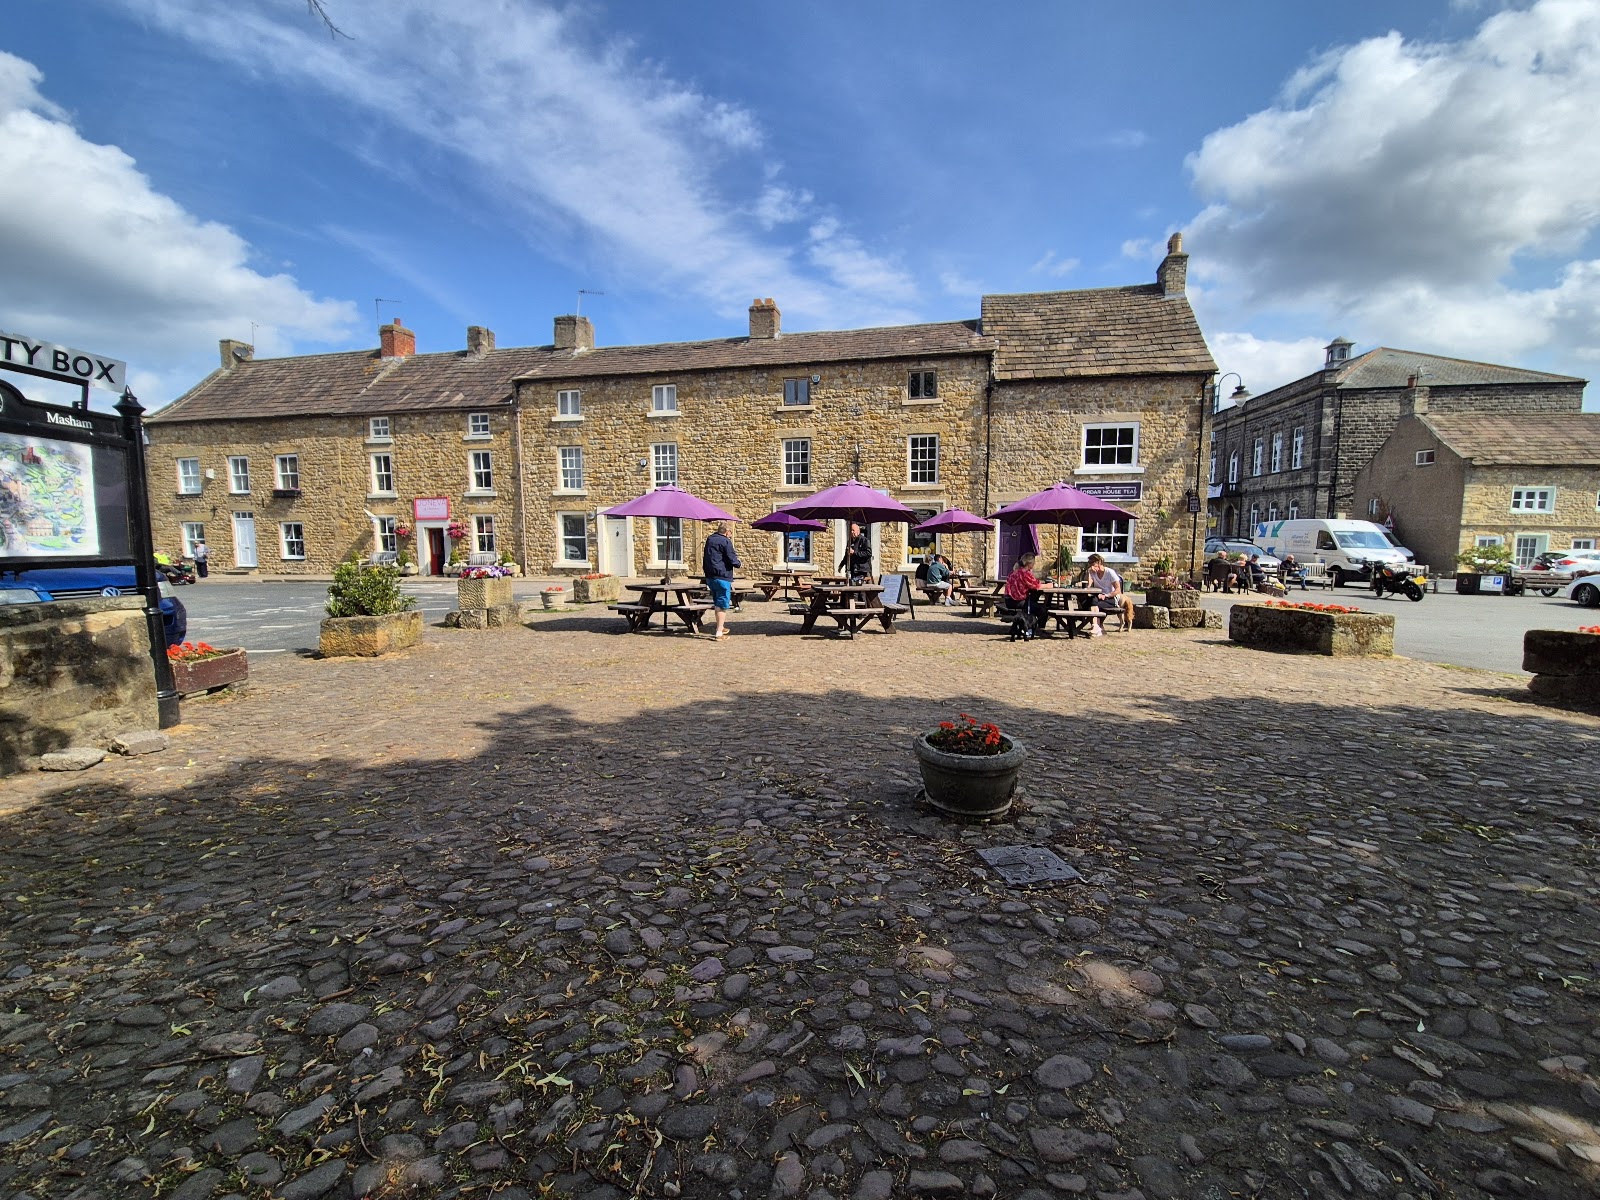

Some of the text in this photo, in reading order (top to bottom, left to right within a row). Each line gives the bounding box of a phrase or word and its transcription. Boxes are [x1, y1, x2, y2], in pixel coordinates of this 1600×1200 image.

[52, 349, 116, 384] BOX
[46, 412, 93, 429] Masham
[1494, 577, 1501, 585] P
